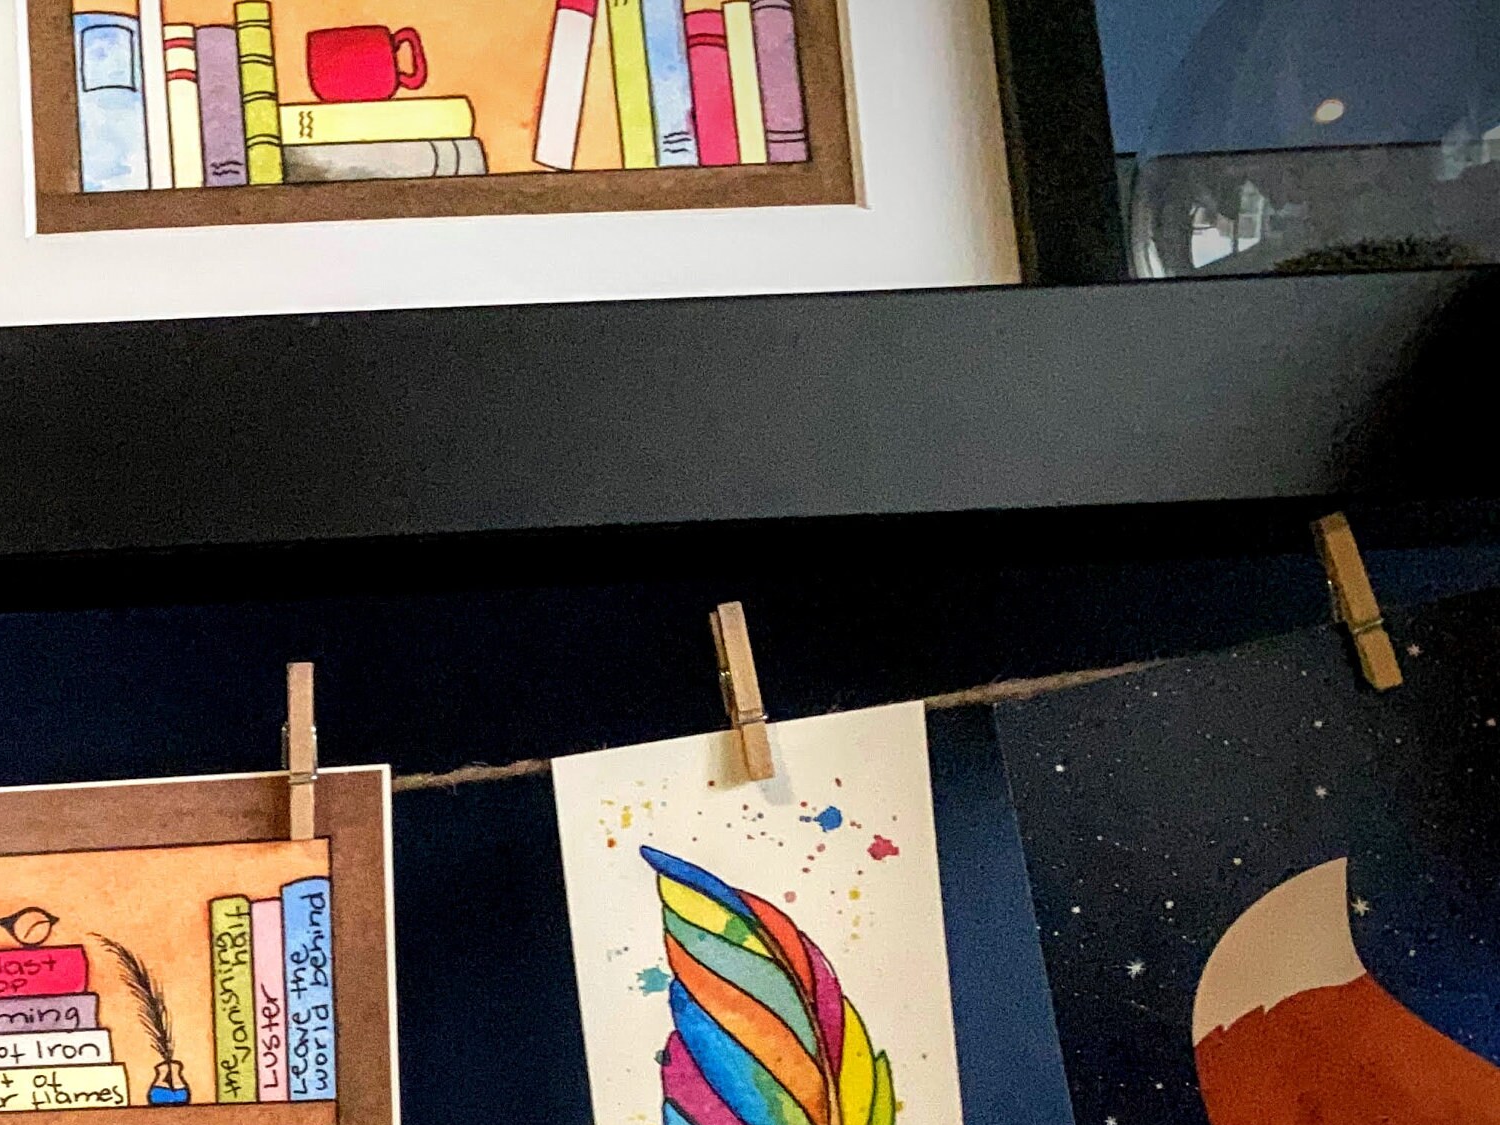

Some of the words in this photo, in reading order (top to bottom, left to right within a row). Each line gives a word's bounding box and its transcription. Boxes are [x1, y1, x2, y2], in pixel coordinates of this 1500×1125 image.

[225, 906, 250, 965] half
[301, 892, 328, 986] behind
[290, 945, 309, 999] the
[37, 1040, 100, 1059] Iron
[261, 983, 281, 1089] Luster
[292, 1011, 311, 1094] Leave
[313, 1004, 329, 1090] world
[32, 1086, 124, 1111] flames
[33, 1072, 62, 1093] of
[221, 1060, 241, 1098] the
